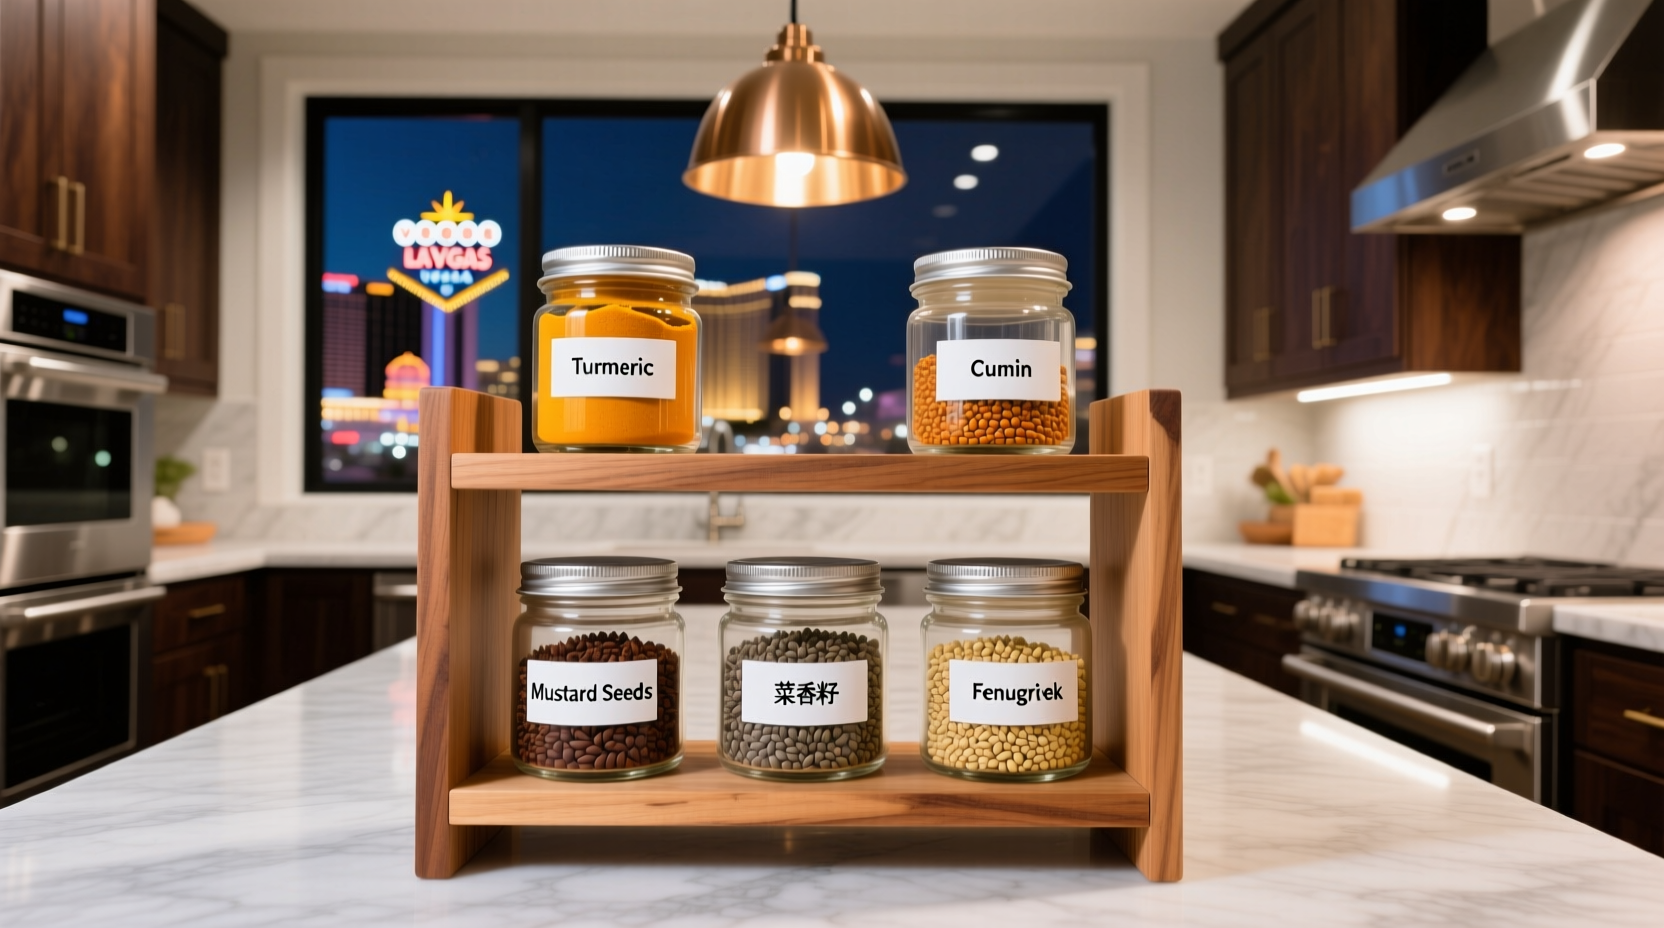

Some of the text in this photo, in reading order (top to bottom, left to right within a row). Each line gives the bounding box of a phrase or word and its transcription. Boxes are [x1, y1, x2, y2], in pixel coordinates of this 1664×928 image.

[402, 246, 493, 271] LAVGAS
[571, 356, 654, 377] Turmeric
[970, 358, 1032, 378] Cumin
[531, 681, 653, 703] Mustard Seeds
[773, 680, 840, 706] 菜香籽
